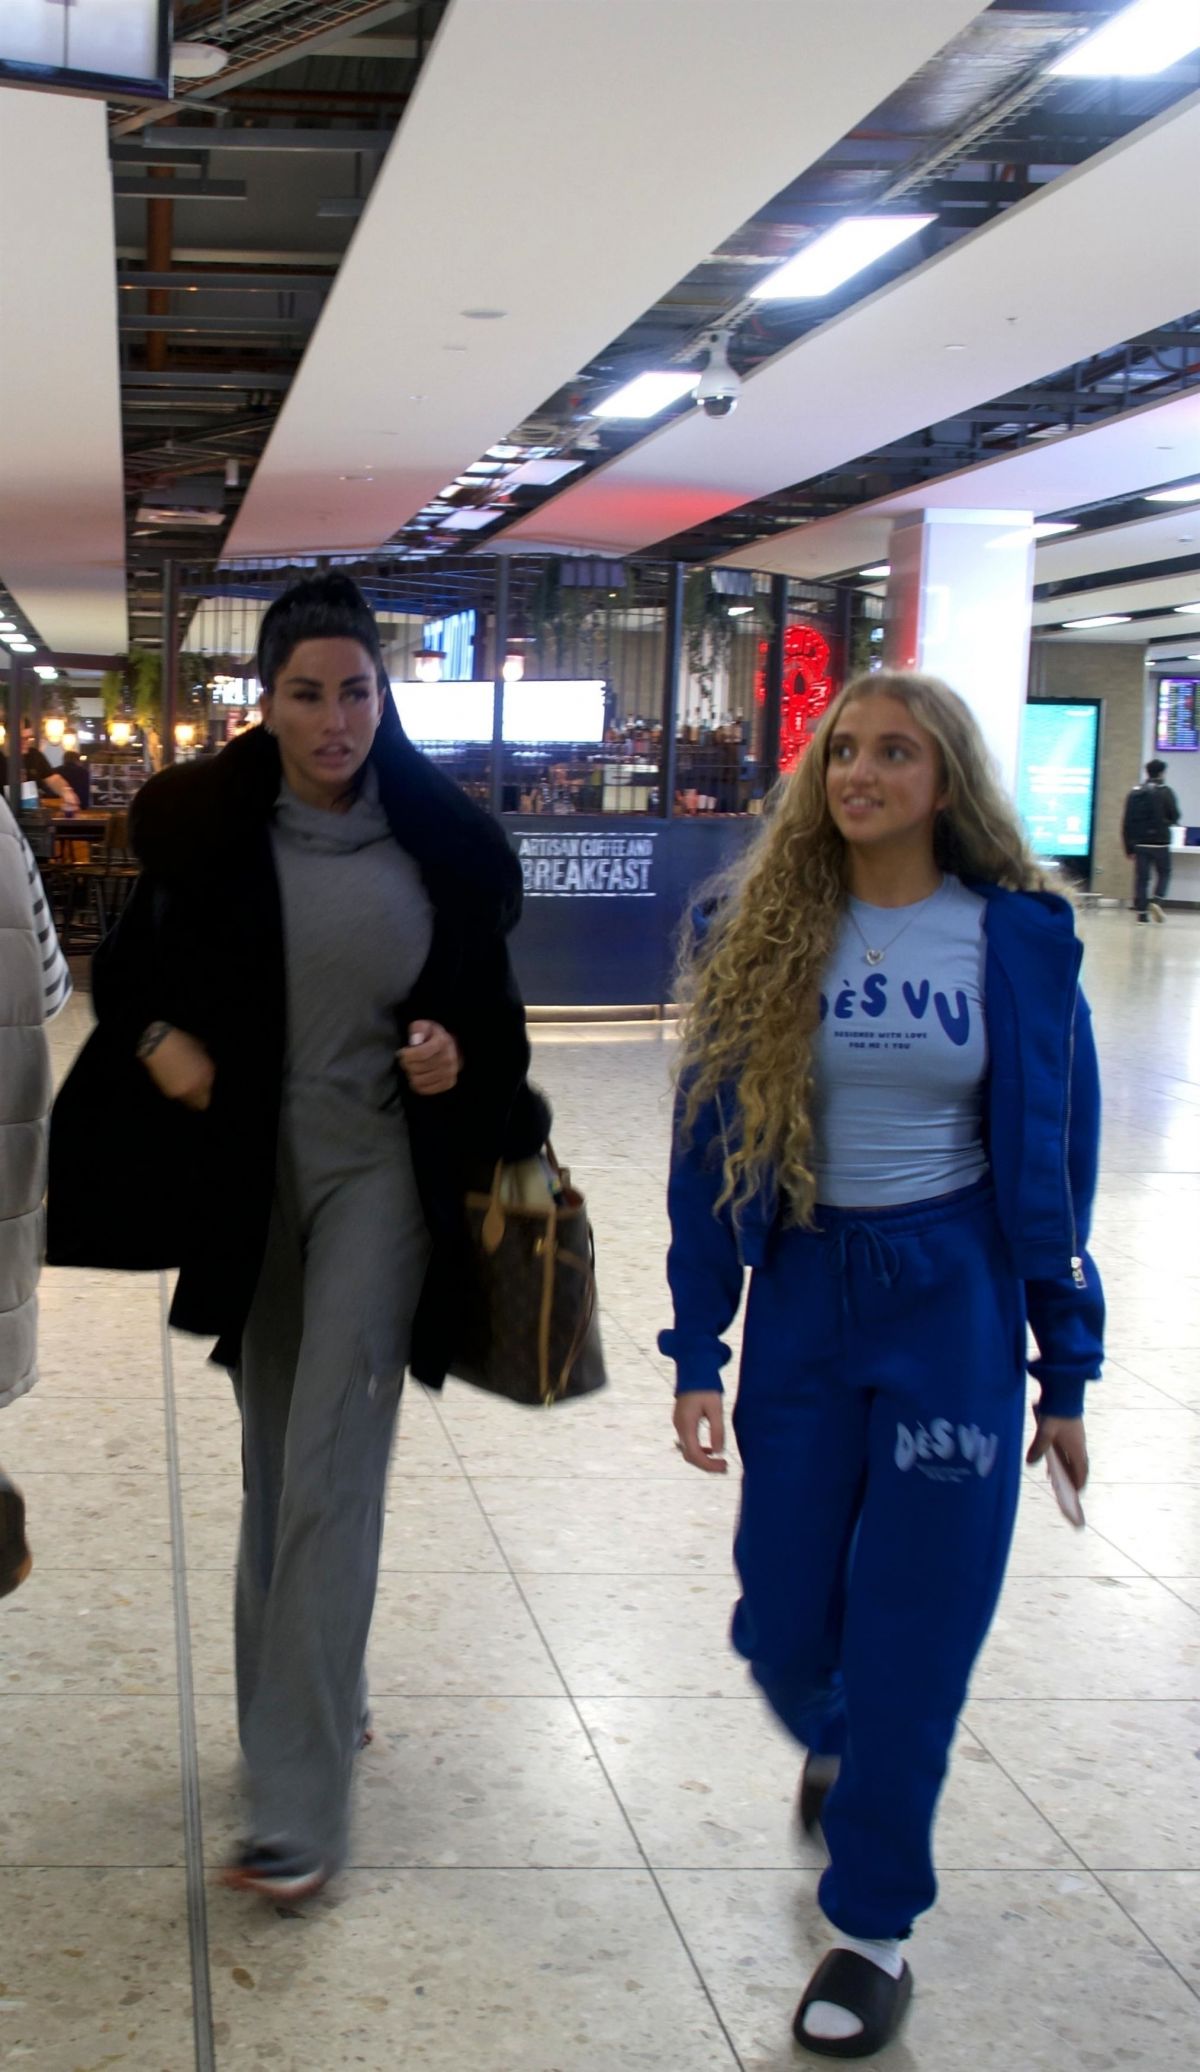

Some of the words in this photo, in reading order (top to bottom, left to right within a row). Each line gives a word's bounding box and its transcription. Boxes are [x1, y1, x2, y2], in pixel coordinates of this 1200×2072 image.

[627, 838, 654, 857] AND
[520, 858, 653, 890] BREAKFAST
[902, 979, 970, 1046] VU
